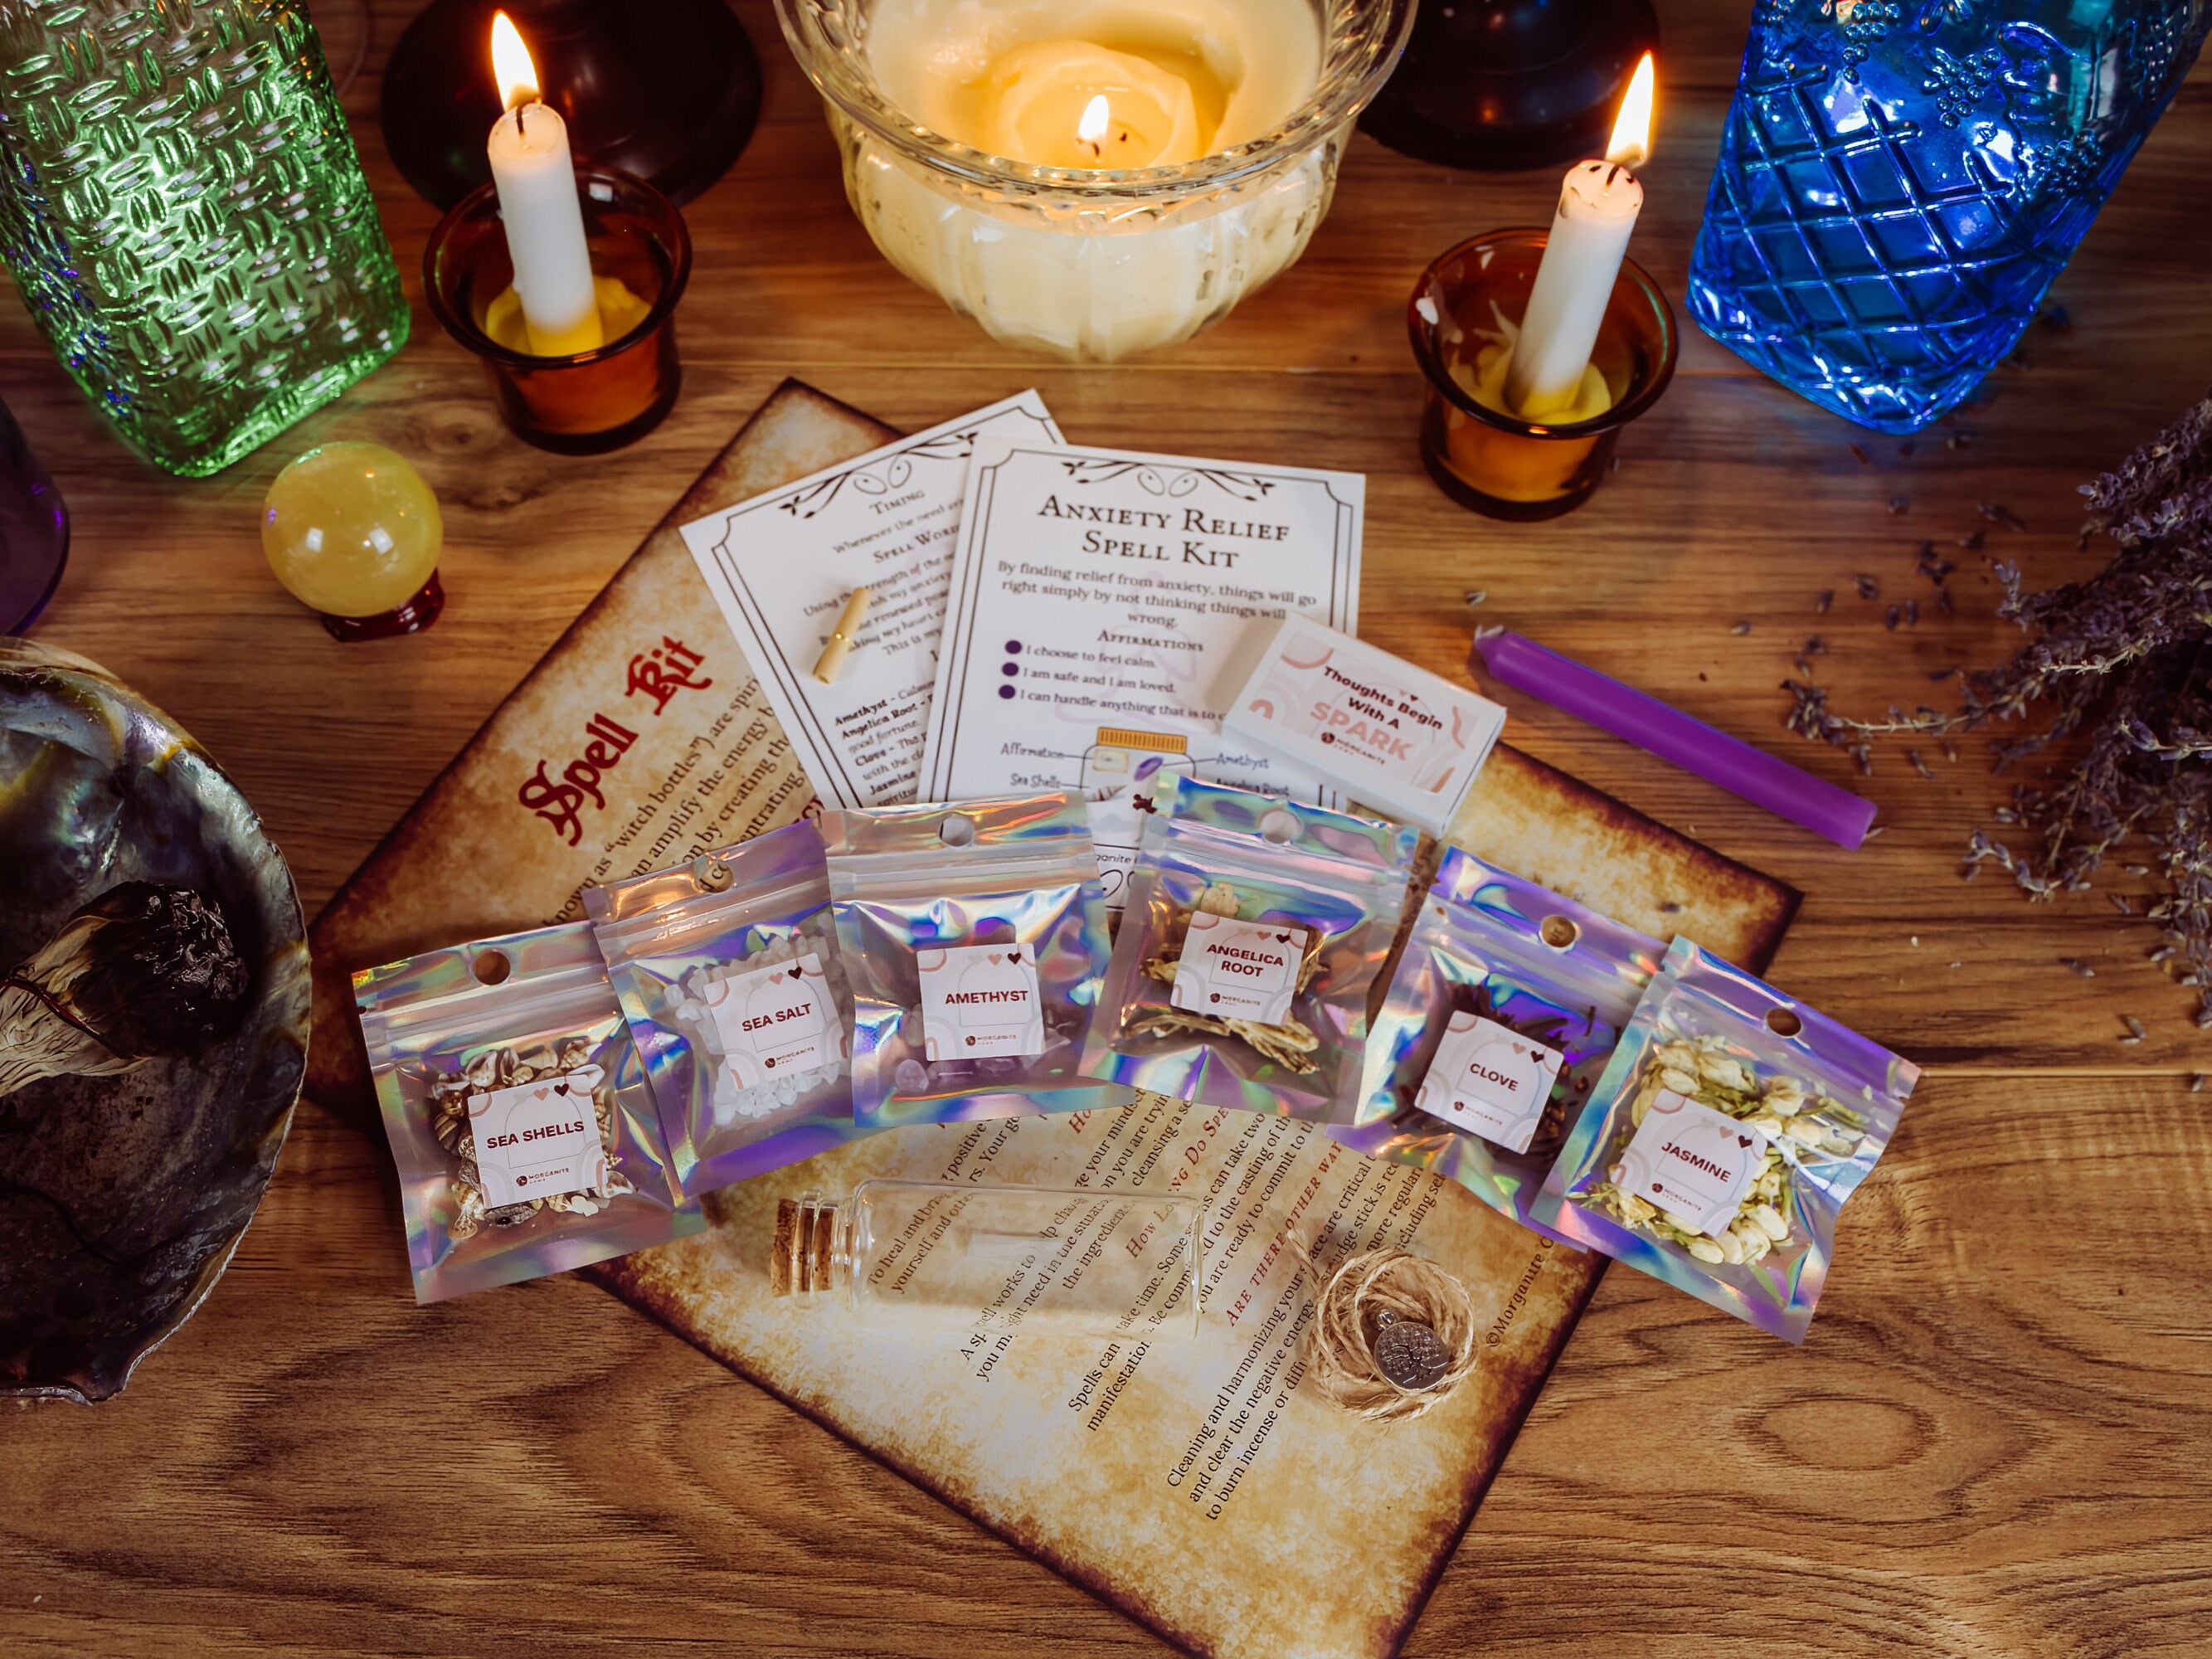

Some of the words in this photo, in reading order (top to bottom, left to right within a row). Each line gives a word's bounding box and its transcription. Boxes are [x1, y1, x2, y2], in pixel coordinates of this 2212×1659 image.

[833, 525, 892, 554] Whenever
[895, 518, 914, 531] the
[917, 505, 945, 522] need
[803, 598, 840, 617] Using
[910, 563, 921, 577] of
[923, 557, 942, 570] the
[998, 561, 1016, 576] By
[1020, 562, 1072, 581] finding
[1076, 570, 1115, 584] relief
[1118, 574, 1153, 587] from
[1157, 580, 1214, 596] anxiety,
[1218, 585, 1264, 601] things
[1269, 590, 1295, 603] will
[1298, 595, 1317, 607] go
[1002, 580, 1037, 595] right
[1042, 585, 1090, 602] simply
[1094, 589, 1111, 605] by
[1116, 593, 1140, 605] not
[1145, 596, 1207, 614] thinking
[1210, 602, 1257, 619] things
[1261, 608, 1286, 620] will
[874, 599, 922, 621] renewed
[901, 612, 934, 630] heart
[1127, 613, 1178, 630] wrong.
[882, 641, 909, 655] This
[911, 634, 922, 645] is
[1033, 646, 1079, 661] choose
[1082, 652, 1096, 662] to
[1098, 652, 1121, 665] feel
[1125, 656, 1156, 669] calm.
[1031, 670, 1050, 679] am
[1054, 671, 1079, 683] safe
[1082, 675, 1106, 686] and
[1117, 680, 1136, 689] am
[1140, 680, 1177, 693] loved.
[1324, 665, 1395, 708] Thoughts
[1398, 702, 1443, 731] Begin
[835, 699, 888, 727] Amethyst
[842, 715, 890, 740] Angelica
[891, 703, 918, 719] Root
[1028, 693, 1052, 703] can
[1053, 693, 1097, 707] handle
[1100, 698, 1156, 717] anything
[1159, 704, 1184, 718] that
[1188, 708, 1200, 718] is
[1202, 710, 1216, 720] to
[1349, 697, 1385, 722] With
[1387, 718, 1400, 730] A
[518, 713, 639, 847] Spell
[625, 635, 712, 716] Kit
[848, 735, 874, 754] good
[1310, 701, 1414, 762] SPARK
[855, 749, 887, 766] Clove
[863, 765, 889, 781] with
[891, 756, 909, 770] the
[999, 742, 1065, 761] Affirmation
[1216, 752, 1269, 771] Amethyst
[596, 860, 612, 877] as
[711, 713, 733, 737] are
[649, 796, 703, 859] amplify
[697, 770, 724, 796] the
[722, 722, 768, 769] energy
[869, 770, 917, 795] Jasmine
[1009, 772, 1028, 786] Sea
[1030, 773, 1062, 790] Shells
[694, 821, 723, 844] by
[718, 758, 777, 822] creating
[1207, 943, 1284, 967] ANGELICA
[1221, 960, 1264, 977] ROOT
[946, 990, 1029, 1005] AMETHYST
[741, 1014, 774, 1032] SEA
[775, 1003, 811, 1023] SALT
[1470, 1063, 1519, 1092] CLOVE
[486, 1133, 519, 1150] SEA
[523, 1121, 586, 1142] SHELLS
[1660, 1141, 1732, 1184] JASMINE
[868, 1267, 885, 1285] To
[878, 1238, 907, 1268] heal
[904, 1214, 926, 1239] and
[947, 1123, 986, 1176] positive
[891, 1237, 934, 1295] yourself
[930, 1215, 952, 1240] and
[978, 1130, 1008, 1162] Your
[1062, 1267, 1083, 1289] the
[1132, 1124, 1179, 1186] cleansing
[1171, 1116, 1183, 1126] a
[1210, 1260, 1228, 1284] are
[1224, 1219, 1256, 1259] ready
[1247, 1204, 1263, 1219] to
[1260, 1151, 1296, 1201] commit
[1290, 1135, 1305, 1151] to
[1148, 1310, 1168, 1326] Be
[1208, 1222, 1225, 1237] to
[1219, 1196, 1240, 1219] the
[1237, 1146, 1275, 1195] casting
[1266, 1129, 1281, 1147] of
[960, 1349, 975, 1361] A
[992, 1269, 1025, 1307] works
[1020, 1255, 1036, 1269] to
[1085, 1140, 1111, 1175] your
[976, 1352, 999, 1383] you
[1023, 1272, 1051, 1306] need
[1047, 1260, 1062, 1273] in
[1111, 1148, 1134, 1176] you
[1130, 1125, 1147, 1148] are
[1068, 1370, 1103, 1412] Spells
[1099, 1343, 1121, 1369] can
[1135, 1277, 1164, 1306] time.
[1157, 1238, 1188, 1274] Some
[1210, 1170, 1230, 1194] can
[1224, 1140, 1249, 1168] take
[1243, 1112, 1266, 1138] two
[1167, 1425, 1216, 1487] Cleaning
[1208, 1394, 1230, 1424] and
[1222, 1306, 1287, 1395] harmonizing
[1279, 1272, 1303, 1311] your
[1323, 1210, 1343, 1234] are
[1339, 1161, 1372, 1209] critical
[1189, 1472, 1212, 1502] and
[1208, 1435, 1233, 1472] clear
[1228, 1410, 1250, 1434] the
[1246, 1349, 1287, 1408] negative
[1354, 1198, 1379, 1229] stick
[1373, 1182, 1386, 1196] is
[1275, 1390, 1289, 1408] or
[1237, 1410, 1278, 1466] incense
[1213, 1467, 1246, 1502] burn
[1205, 1504, 1223, 1520] to
